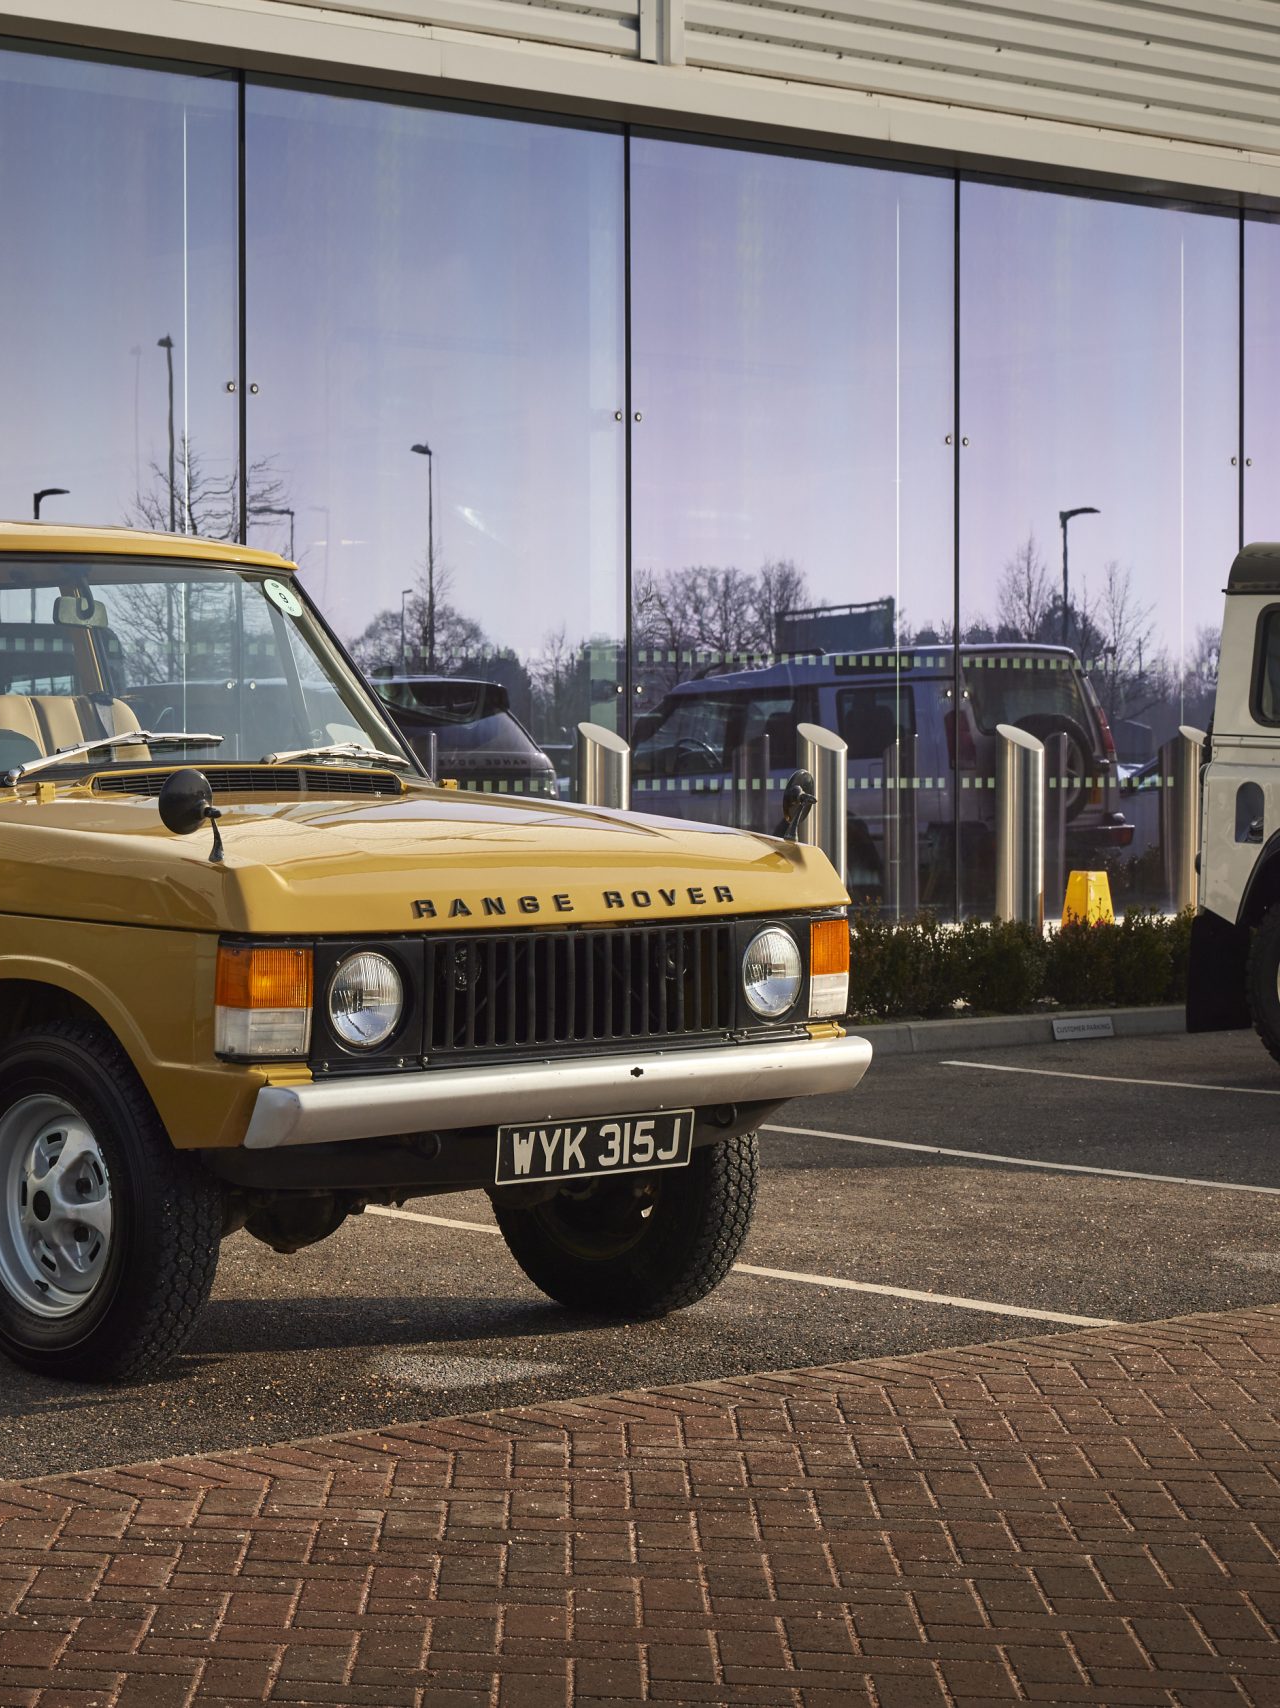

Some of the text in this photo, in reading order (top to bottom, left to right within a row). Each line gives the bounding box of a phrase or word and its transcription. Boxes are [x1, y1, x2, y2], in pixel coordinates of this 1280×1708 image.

[410, 885, 735, 920] RANGE ROVER
[1056, 1022, 1112, 1033] CUSTOMER PARKING
[512, 1118, 681, 1175] WYK 315J
